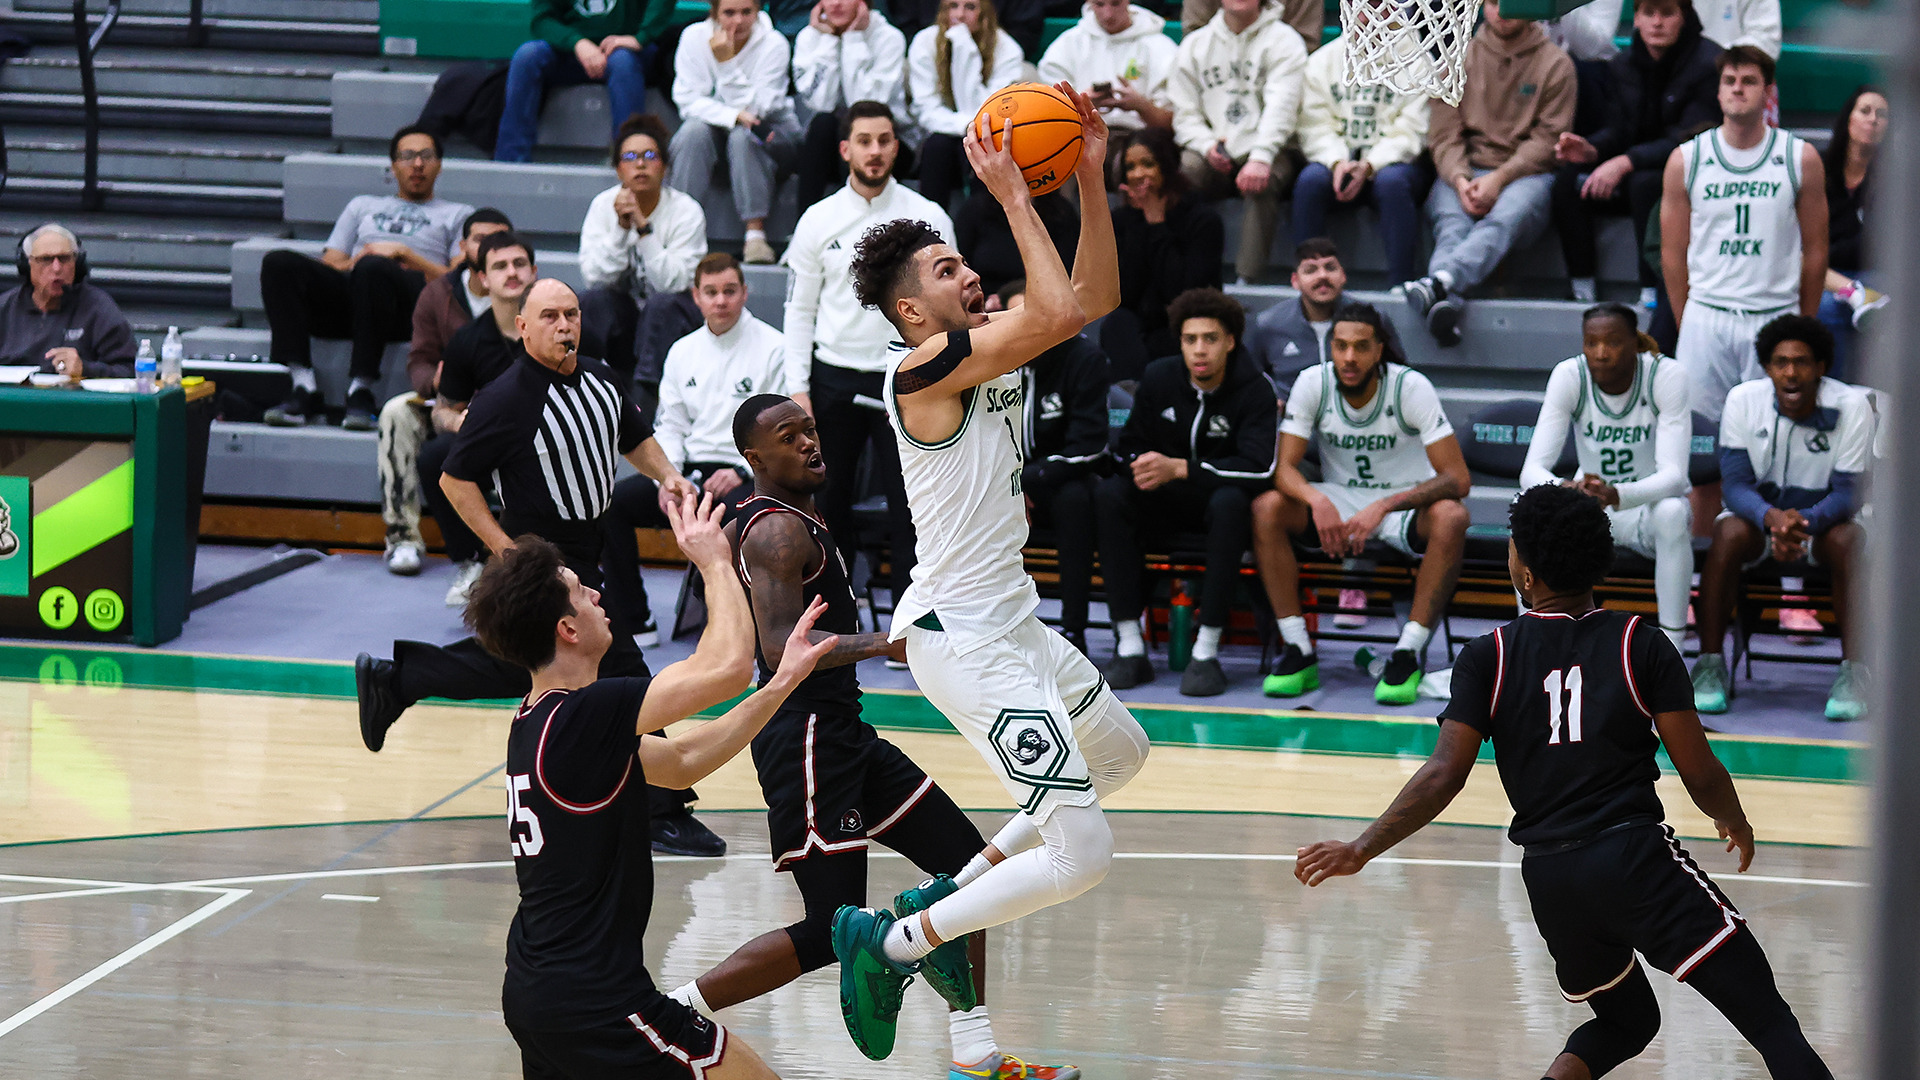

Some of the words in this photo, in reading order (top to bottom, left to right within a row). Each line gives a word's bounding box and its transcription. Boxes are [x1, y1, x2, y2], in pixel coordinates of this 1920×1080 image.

[1026, 170, 1056, 190] NC
[1703, 181, 1781, 200] SLIPPERY
[1735, 203, 1750, 234] 11
[1719, 240, 1763, 256] ROCK
[1584, 421, 1651, 443] SIPPERY
[1355, 455, 1374, 479] 2
[1601, 449, 1634, 475] 22
[1543, 665, 1583, 745] 11
